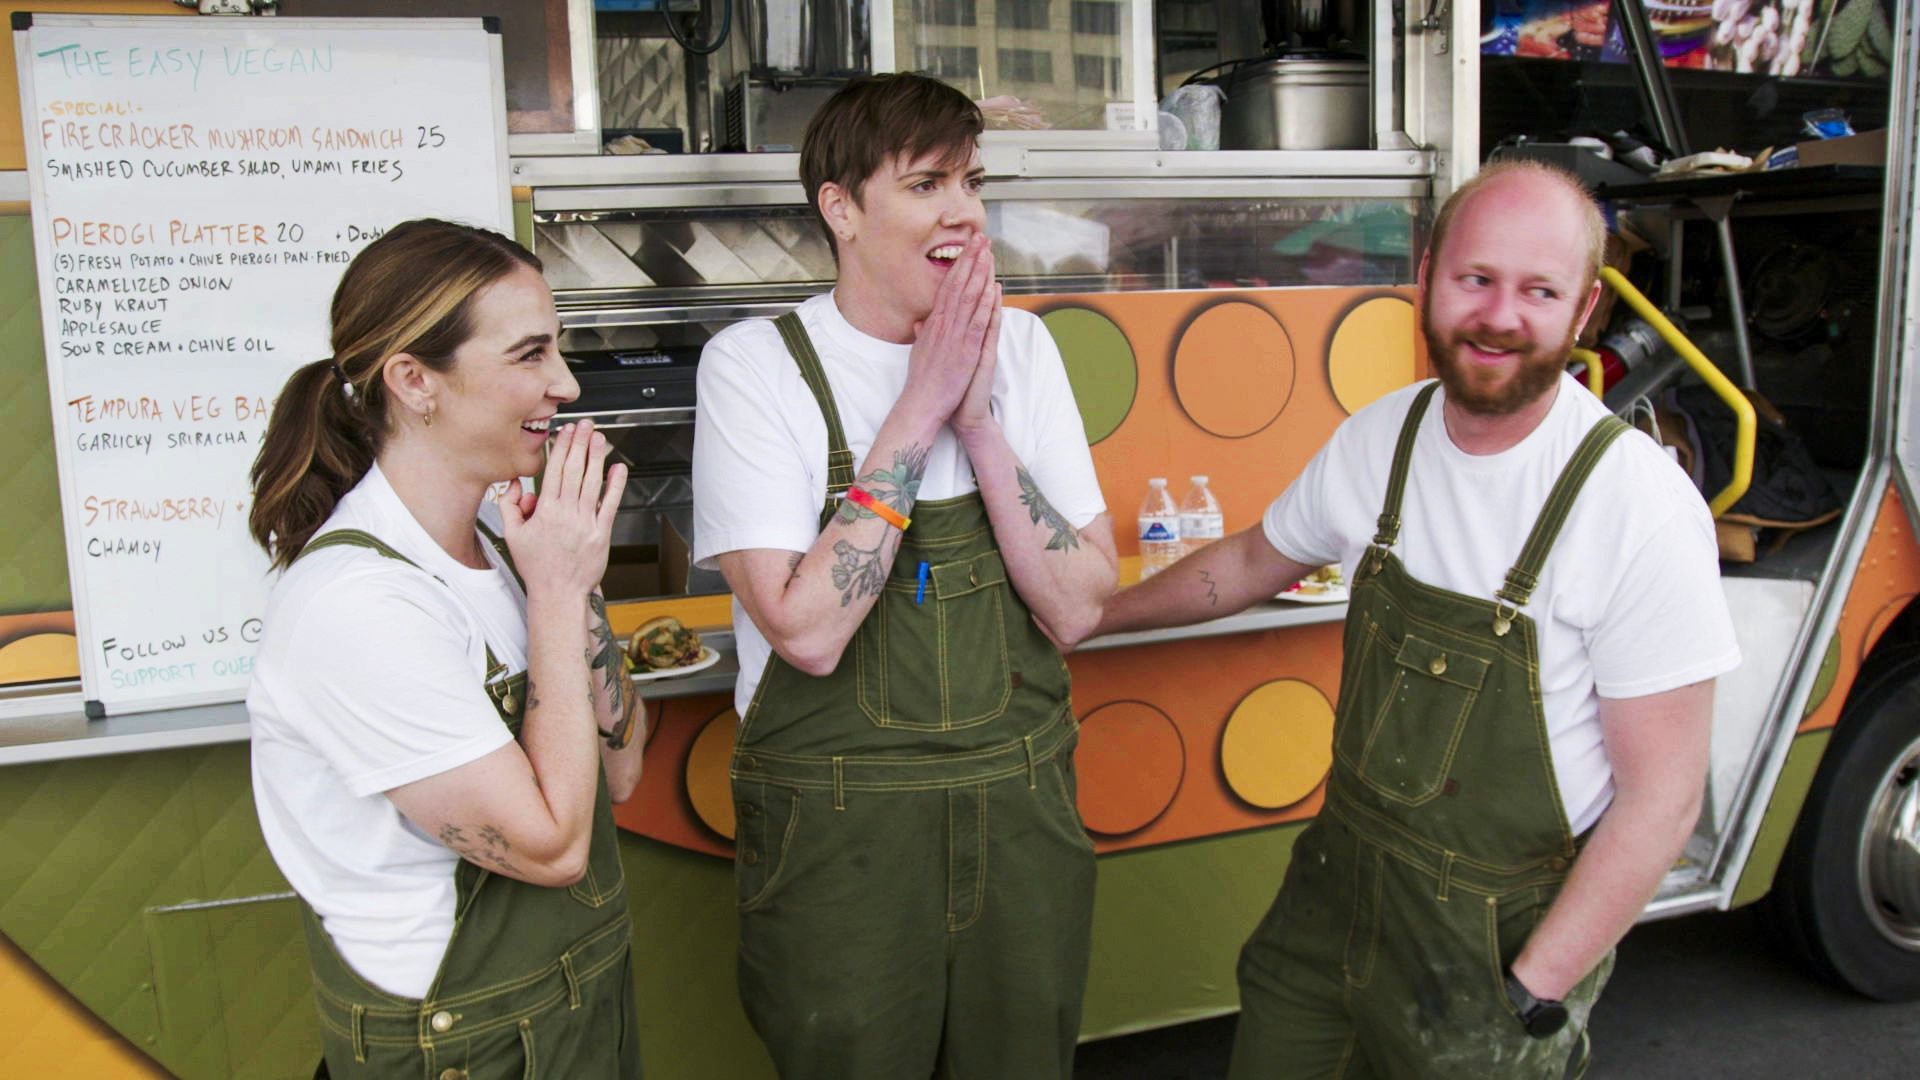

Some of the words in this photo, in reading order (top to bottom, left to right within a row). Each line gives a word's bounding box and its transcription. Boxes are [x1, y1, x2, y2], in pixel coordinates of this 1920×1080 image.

[37, 44, 113, 79] THE
[128, 47, 203, 91] EASY
[224, 44, 334, 77] VEGAN
[208, 126, 303, 152] MUSHROOM
[312, 126, 404, 151] SANDWICH
[417, 125, 446, 149] 25
[47, 159, 134, 181] SMASHED
[143, 158, 233, 179] CUCUMBER
[291, 158, 342, 177] UMAMI
[351, 158, 404, 182] FRIES
[53, 217, 156, 248] PIEROGI
[169, 219, 270, 247] PLATTER
[276, 222, 304, 244] 20
[130, 253, 174, 269] POTATO
[189, 252, 224, 267] CHIVE
[230, 252, 278, 267] PIEROGI
[56, 276, 170, 295] CARAMELIZED
[179, 275, 234, 292] ONION
[59, 299, 103, 321] RUBY
[115, 298, 168, 314] KRAUT
[61, 319, 162, 338] APPLESAUCE
[60, 341, 105, 359] SOUR
[113, 340, 171, 356] CREAM
[188, 339, 236, 353] CHIVE
[244, 338, 275, 352] OIL
[68, 394, 164, 423] TEMPURA
[173, 395, 221, 421] VEG
[235, 396, 277, 421] BA
[77, 431, 152, 455] GARLICKY
[167, 430, 247, 449] SRIRACHA
[84, 496, 226, 530] STRAWBERRY
[87, 537, 161, 562] CHAMOY
[102, 635, 186, 669] FOLLOW
[202, 626, 229, 644] US
[110, 661, 197, 690] SUPPORT
